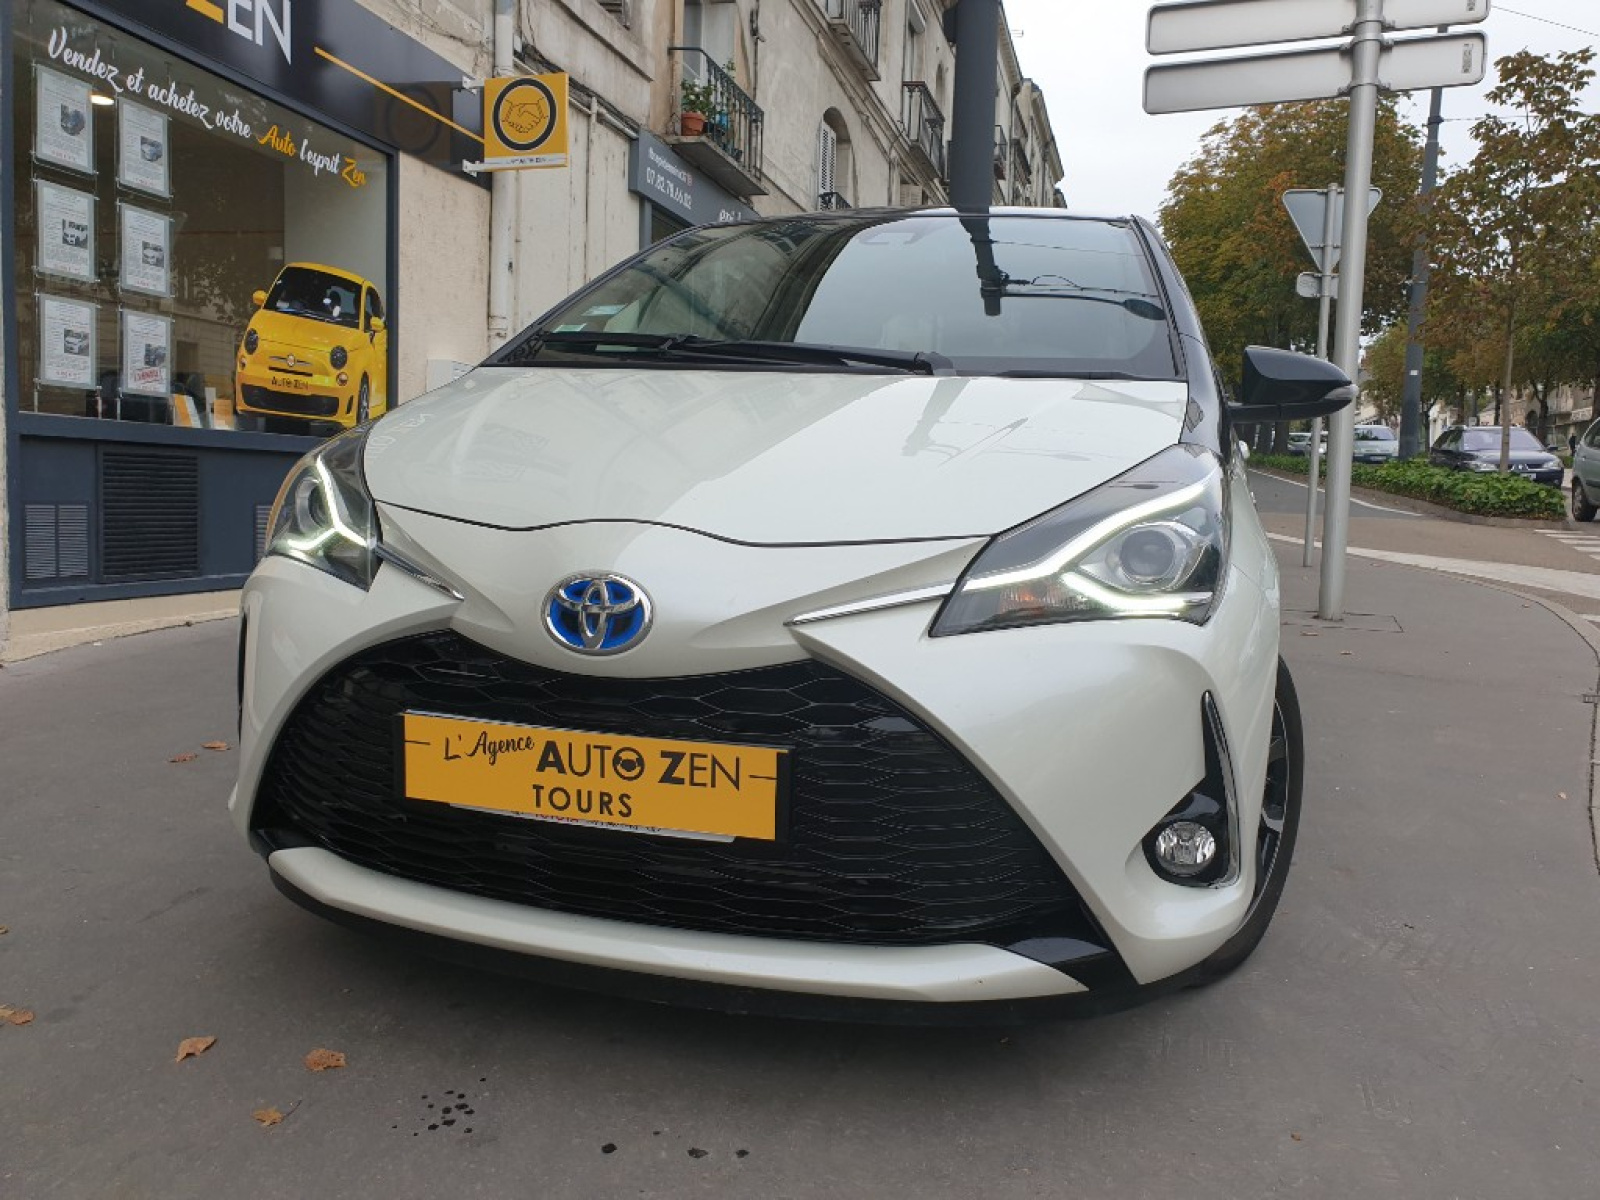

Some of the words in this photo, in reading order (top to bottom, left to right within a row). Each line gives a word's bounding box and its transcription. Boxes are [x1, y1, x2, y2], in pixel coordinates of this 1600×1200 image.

[186, 0, 291, 65] EN
[48, 26, 123, 92] Vendez
[126, 67, 144, 93] et
[148, 81, 214, 129] achetez
[216, 109, 251, 139] votre
[256, 125, 297, 156] Auto
[342, 157, 366, 187] Zen
[536, 740, 645, 781] AUTO
[658, 750, 740, 791] ZEN
[532, 784, 632, 818] TOURS
